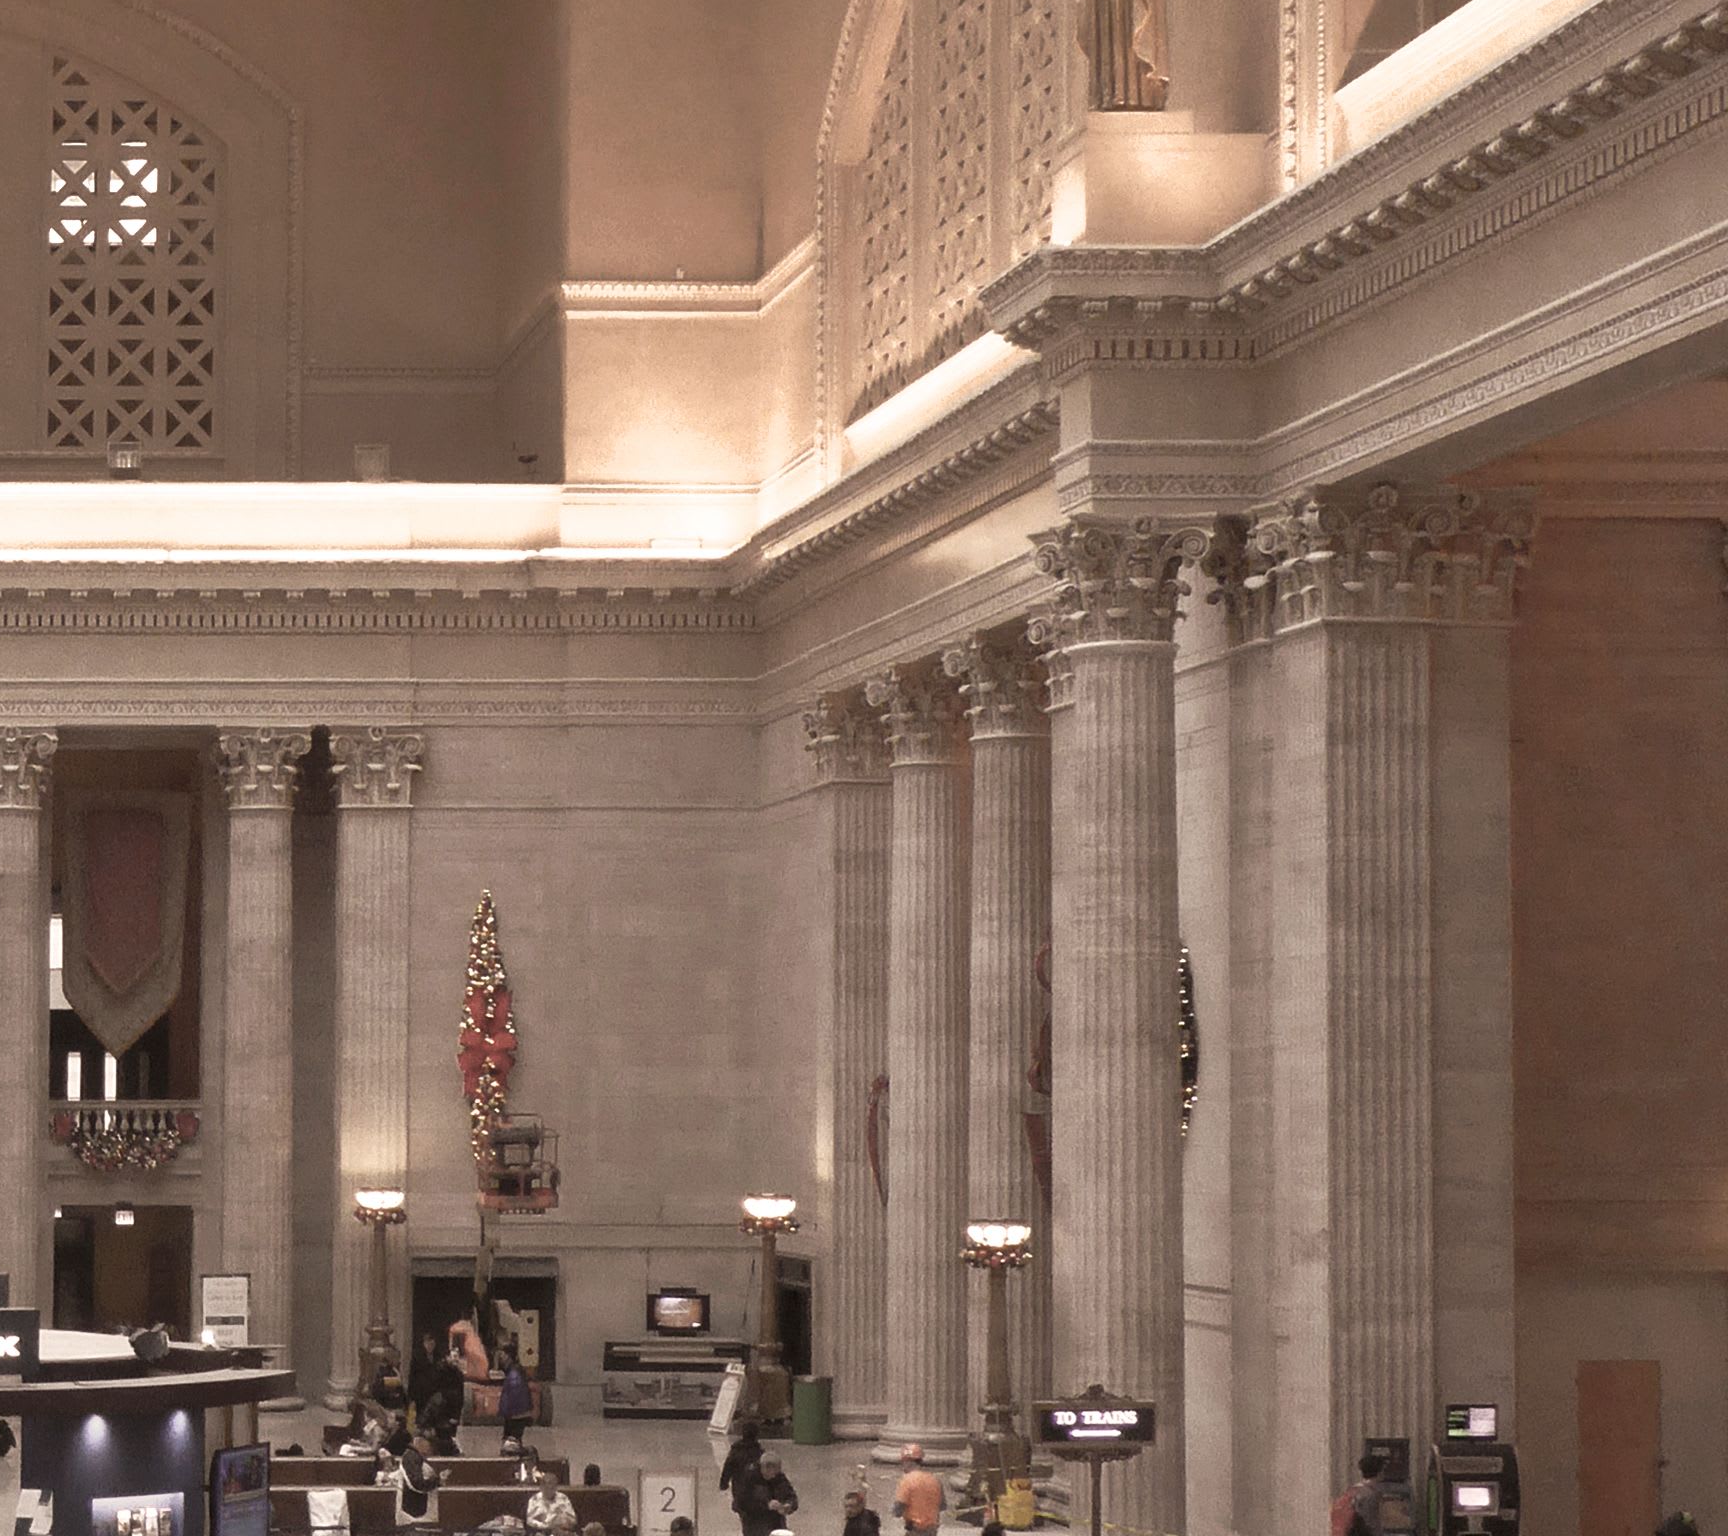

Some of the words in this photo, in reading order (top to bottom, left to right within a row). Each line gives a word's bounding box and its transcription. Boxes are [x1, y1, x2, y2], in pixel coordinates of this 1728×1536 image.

[1053, 1410, 1077, 1426] TO
[1081, 1410, 1138, 1425] TRAINS
[659, 1486, 676, 1513] 2
